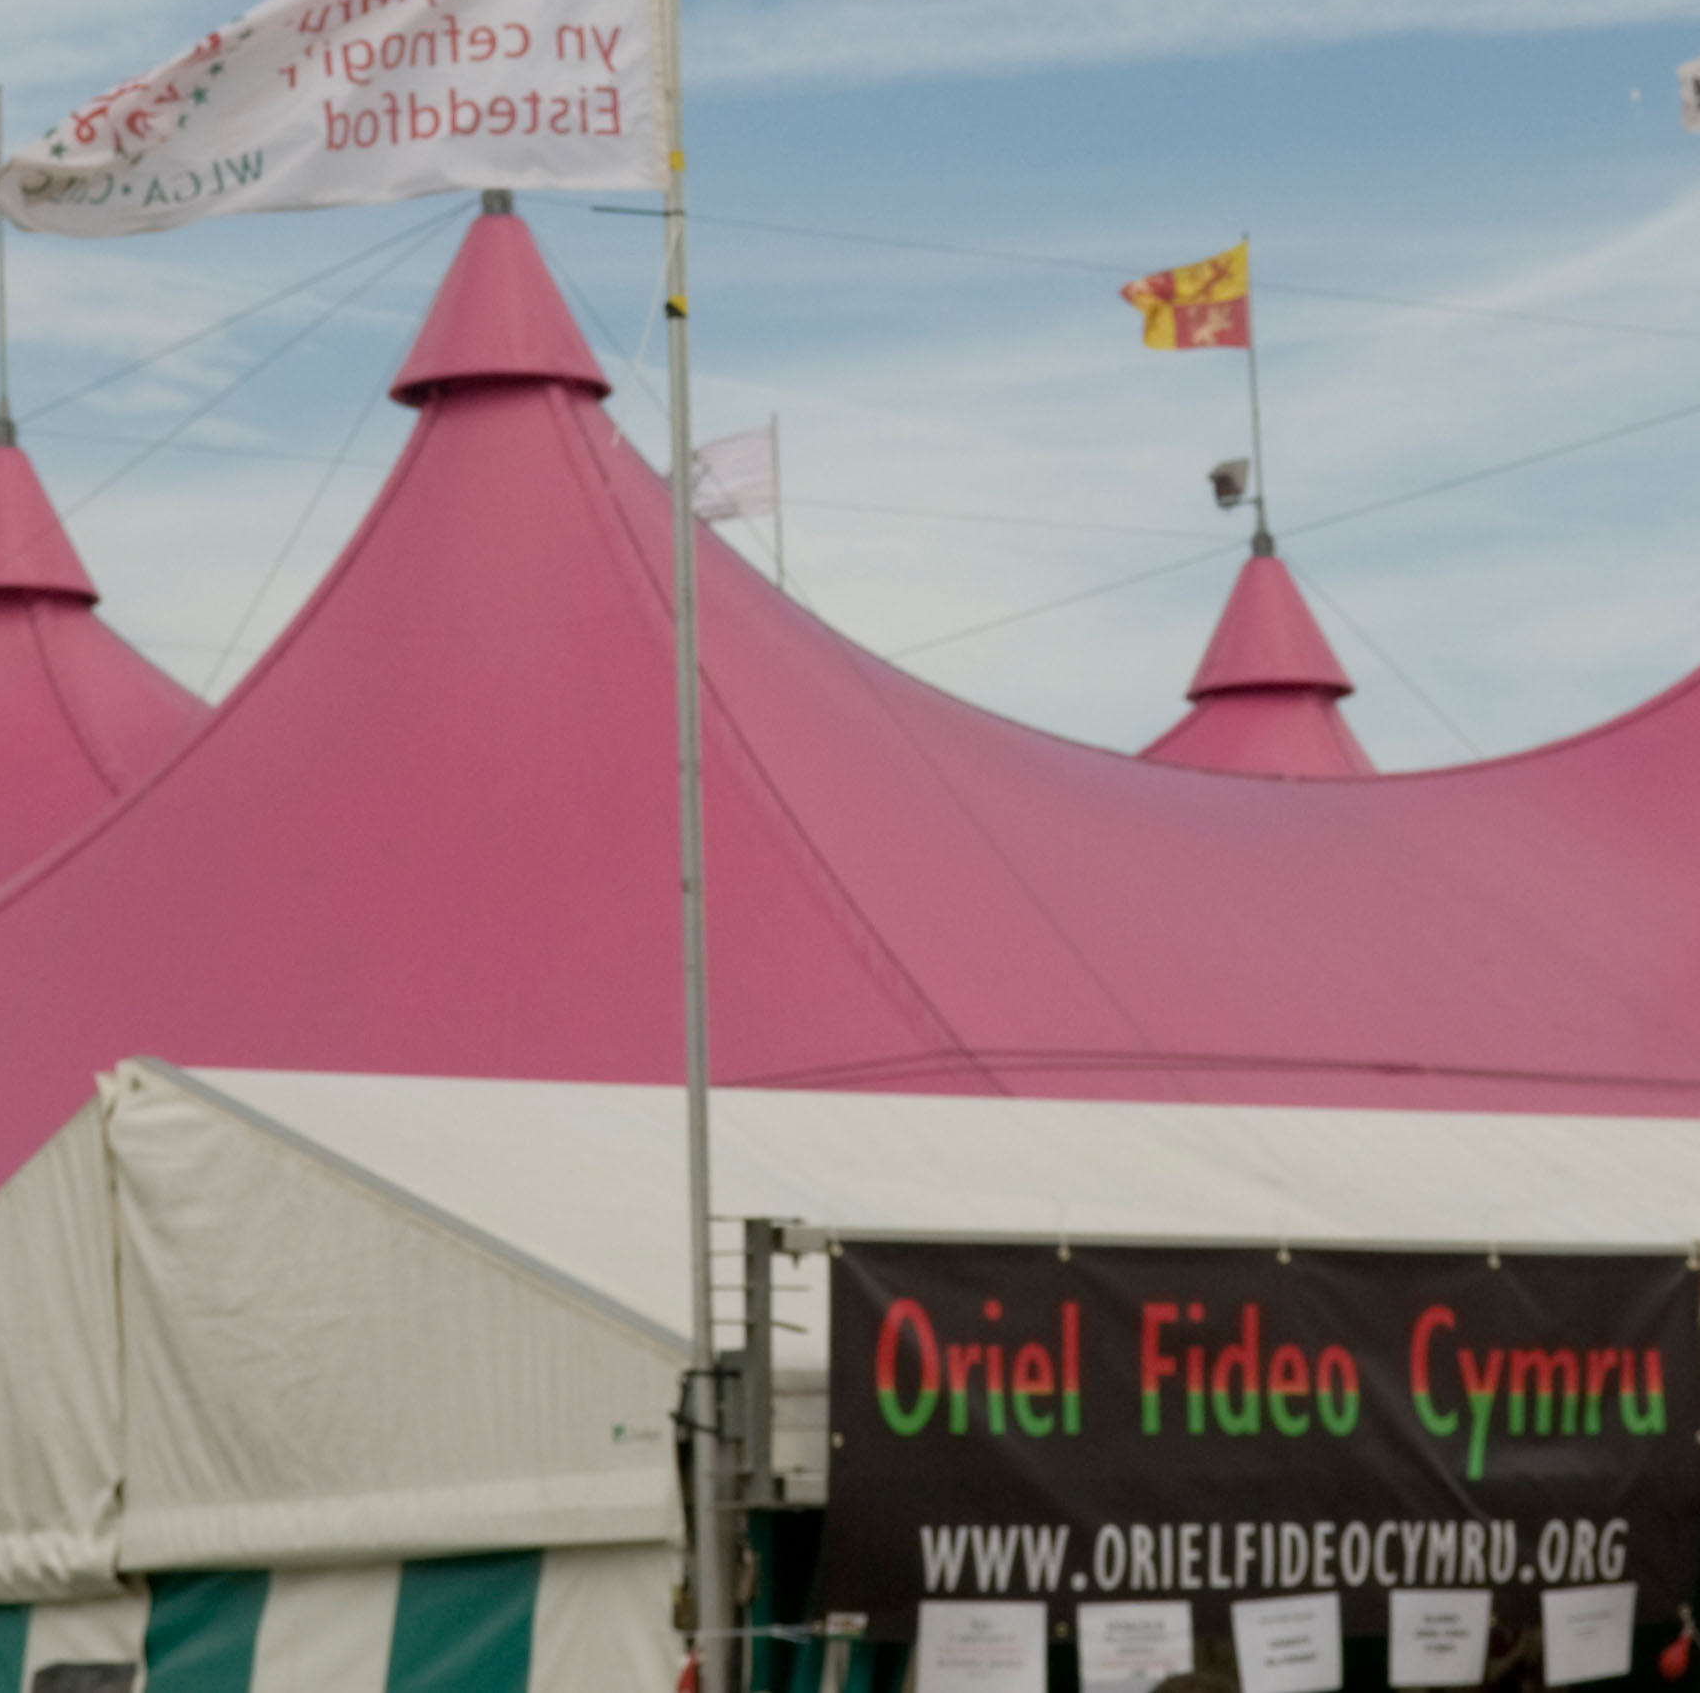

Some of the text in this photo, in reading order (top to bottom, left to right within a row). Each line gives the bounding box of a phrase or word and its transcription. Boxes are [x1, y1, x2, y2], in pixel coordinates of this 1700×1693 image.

[874, 1297, 1668, 1482] Oriel Fideo Cymru
[920, 1519, 1631, 1591] WWW.ORIELFIDEOCYMRU.ORG
